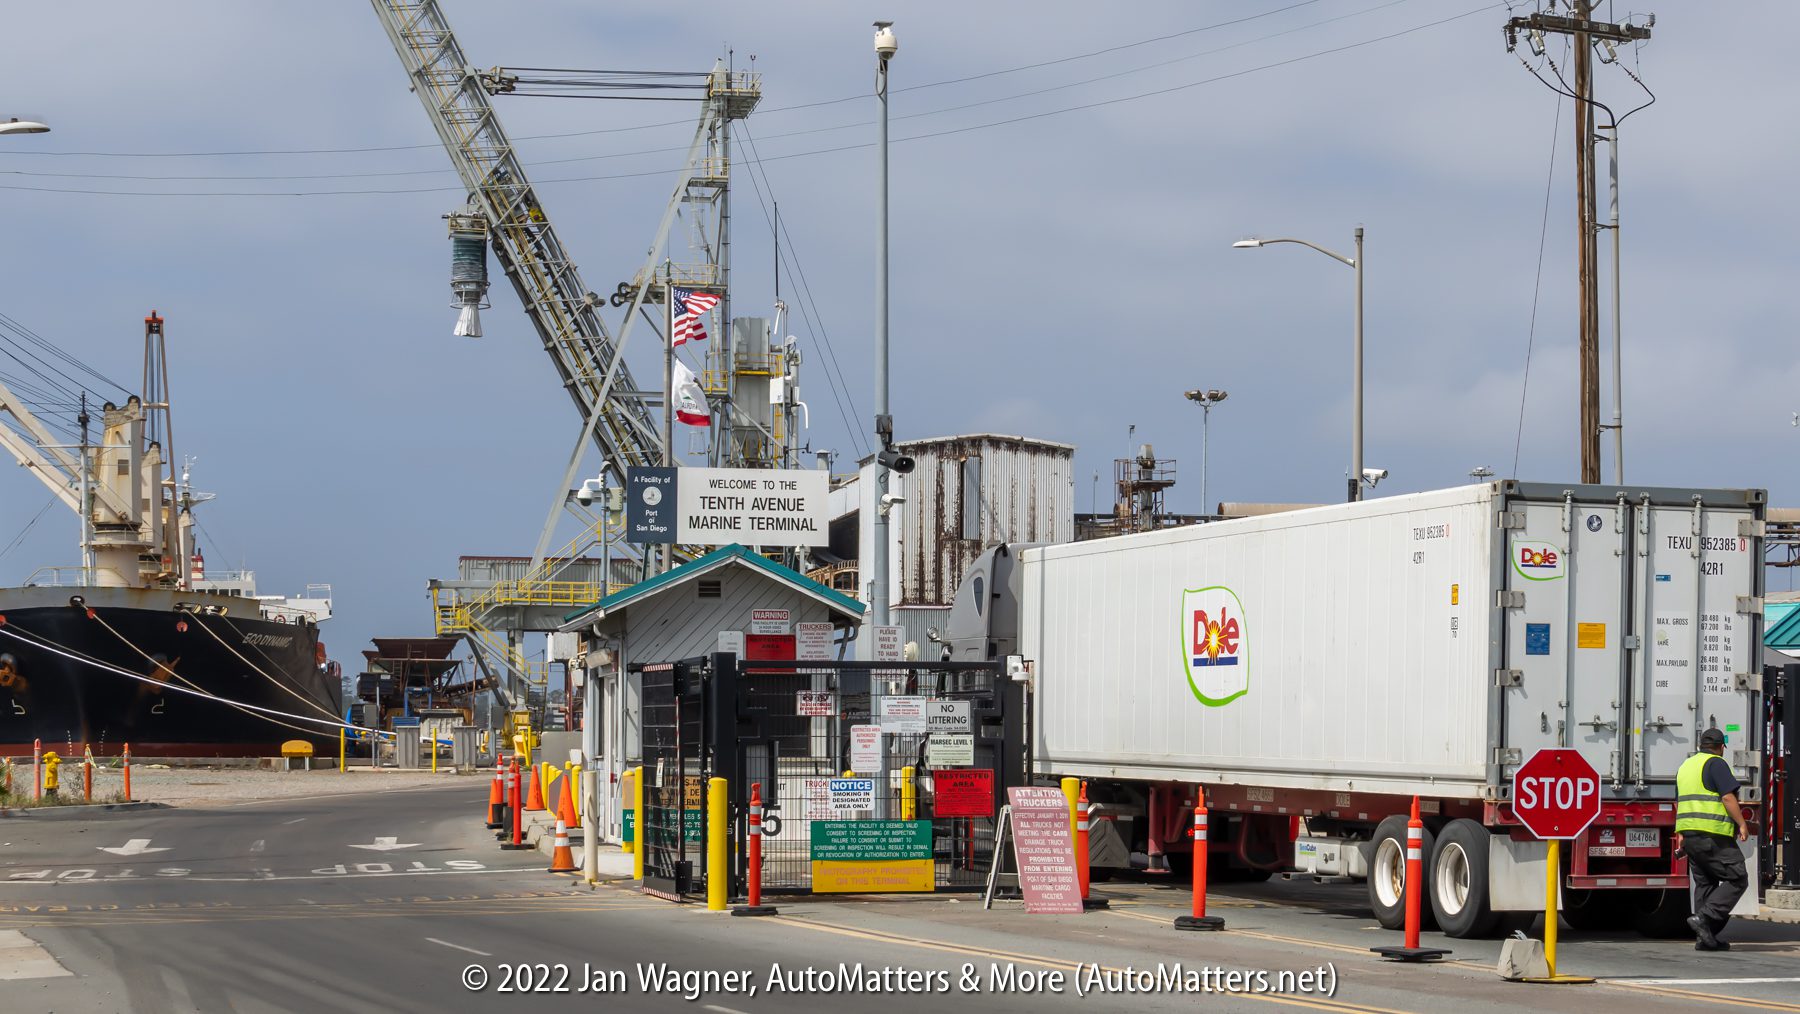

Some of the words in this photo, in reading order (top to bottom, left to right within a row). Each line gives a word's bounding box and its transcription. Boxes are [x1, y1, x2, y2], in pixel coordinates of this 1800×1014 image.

[640, 476, 662, 485] Facility
[709, 479, 756, 490] WELCOME
[763, 480, 775, 490] TO
[779, 480, 797, 491] THE
[699, 496, 744, 510] TENTH
[751, 497, 805, 512] AVENUE
[689, 516, 741, 530] MARINE
[749, 517, 817, 531] TERMINAL
[636, 524, 648, 532] San
[649, 524, 667, 533] Diego
[1413, 527, 1425, 541] TEXU
[1426, 524, 1445, 539] 952385
[1667, 536, 1692, 549] TEXU
[1700, 537, 1736, 551] 952385
[1740, 538, 1746, 551] 0
[1413, 551, 1425, 564] 42R1
[1521, 548, 1557, 567] Dole
[1700, 562, 1723, 575] 42R1
[753, 611, 788, 620] WARNING
[1724, 615, 1731, 623] kg
[1193, 607, 1240, 657] Dole
[242, 632, 261, 645] ECO
[260, 634, 293, 648] DYNAMIC
[1724, 636, 1731, 644] kg
[1723, 656, 1730, 664] kg
[941, 704, 955, 713] NO
[928, 716, 967, 724] LITTERING
[930, 738, 952, 746] MARSEC
[831, 782, 871, 790] NOTICE
[1015, 789, 1062, 798] ATTENTION
[1519, 776, 1595, 810] STOP
[1016, 798, 1063, 807] TRUCKERS
[312, 860, 486, 875] STOP
[852, 877, 868, 885] THIS
[873, 877, 911, 885] TERMINAL
